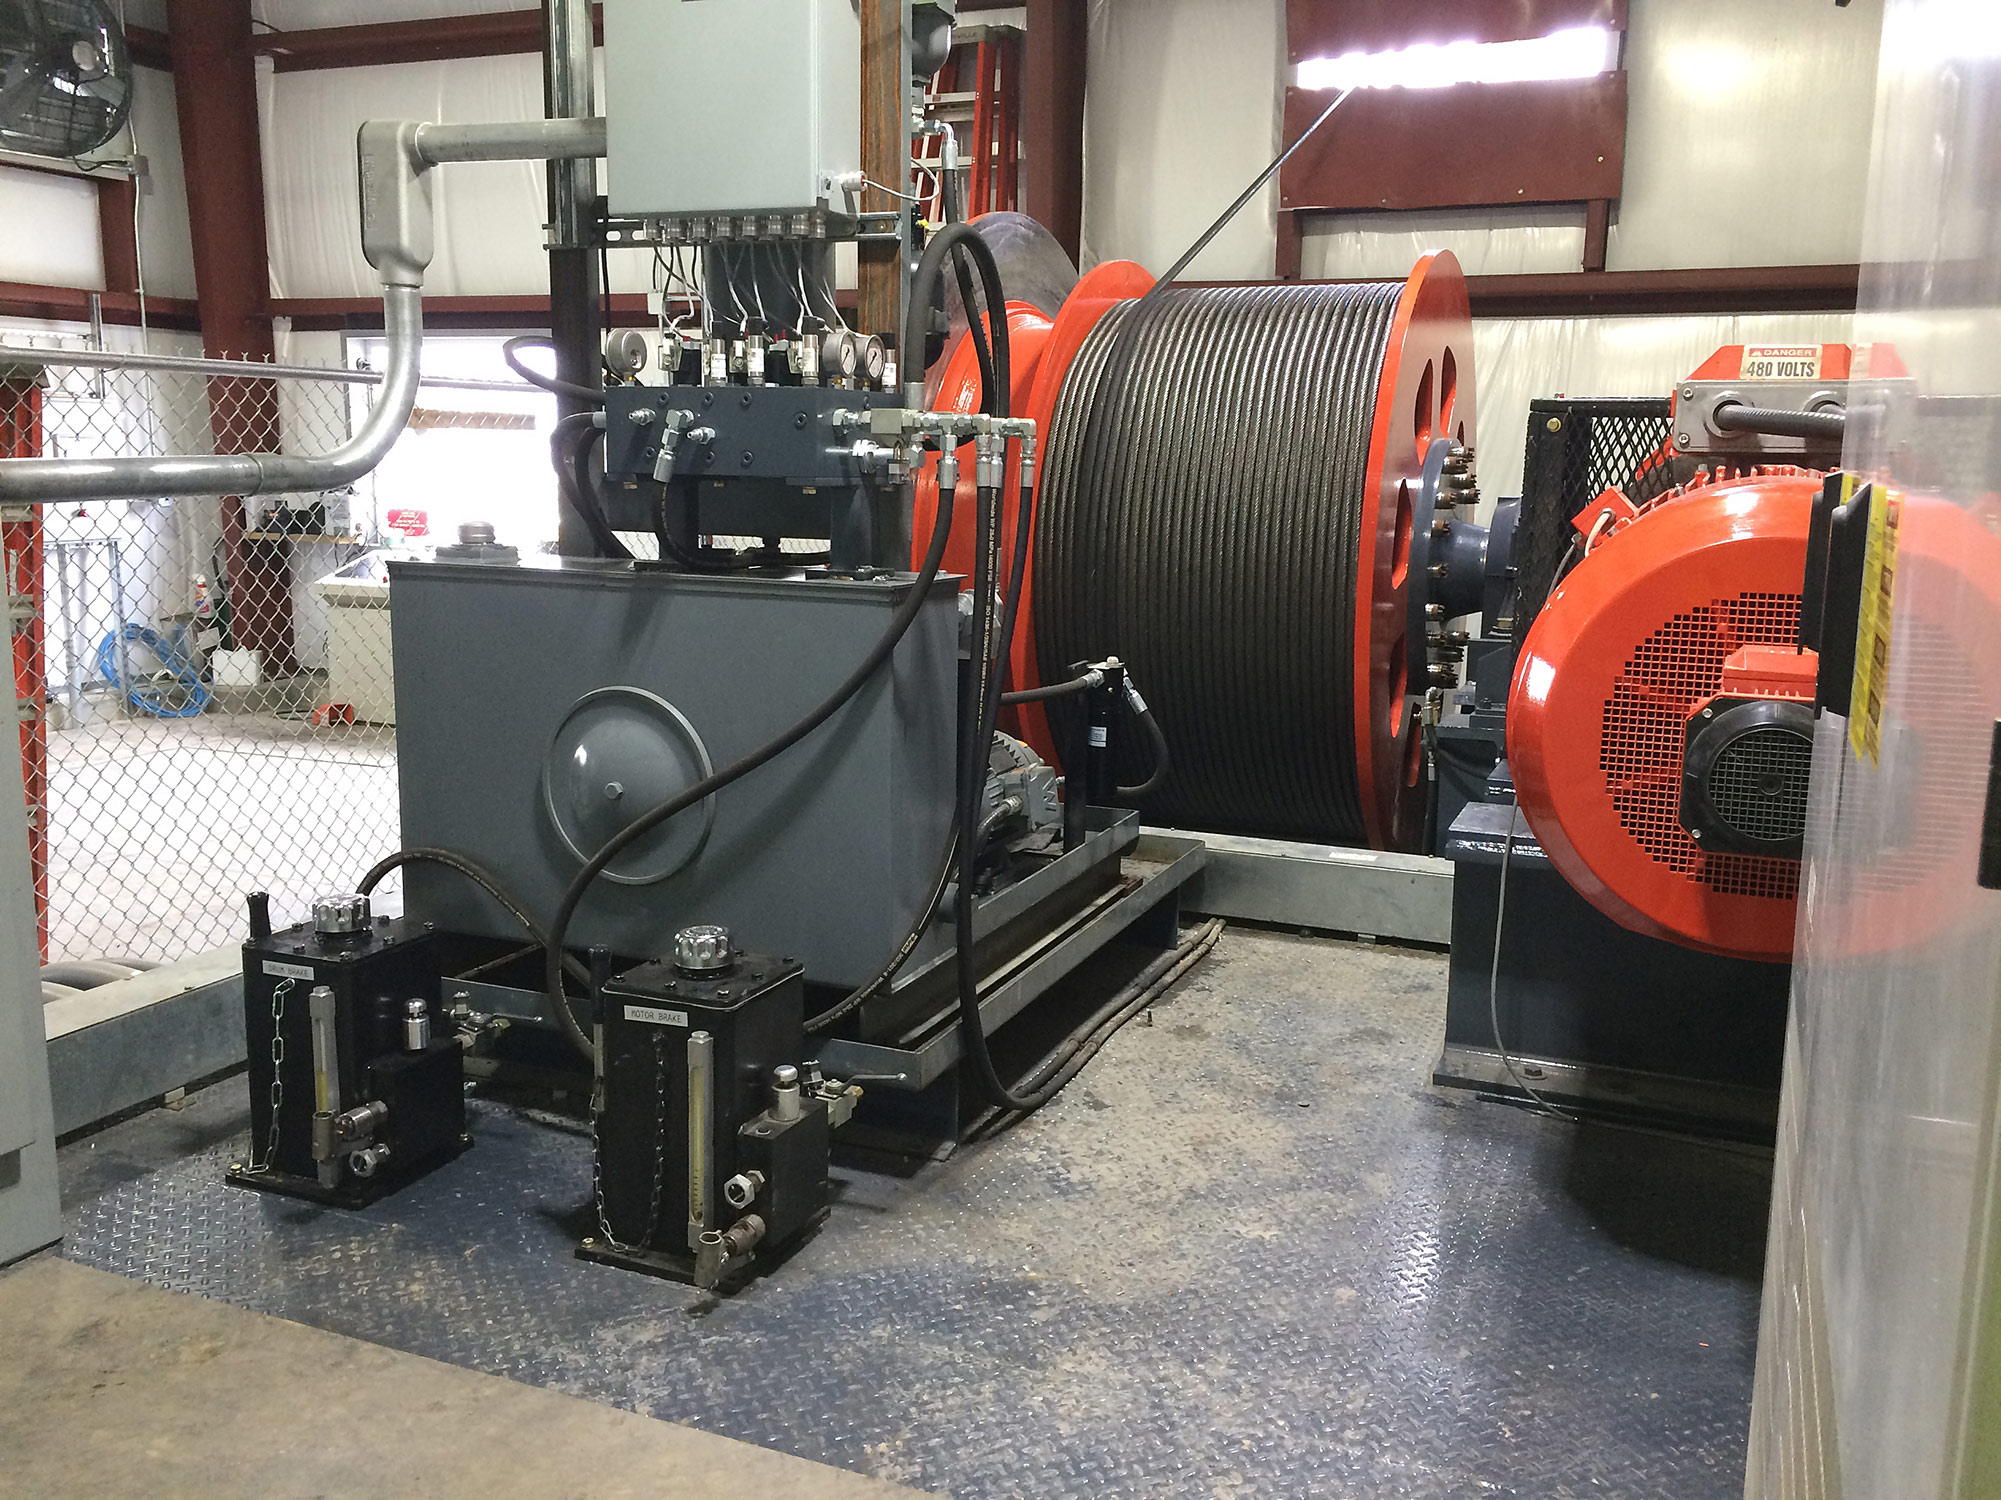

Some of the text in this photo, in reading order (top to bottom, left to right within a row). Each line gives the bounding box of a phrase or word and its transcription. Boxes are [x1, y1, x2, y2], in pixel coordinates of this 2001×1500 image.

[1747, 361, 1816, 377] 480 VOLTS
[631, 1009, 682, 1024] MOTOR BRAKE
